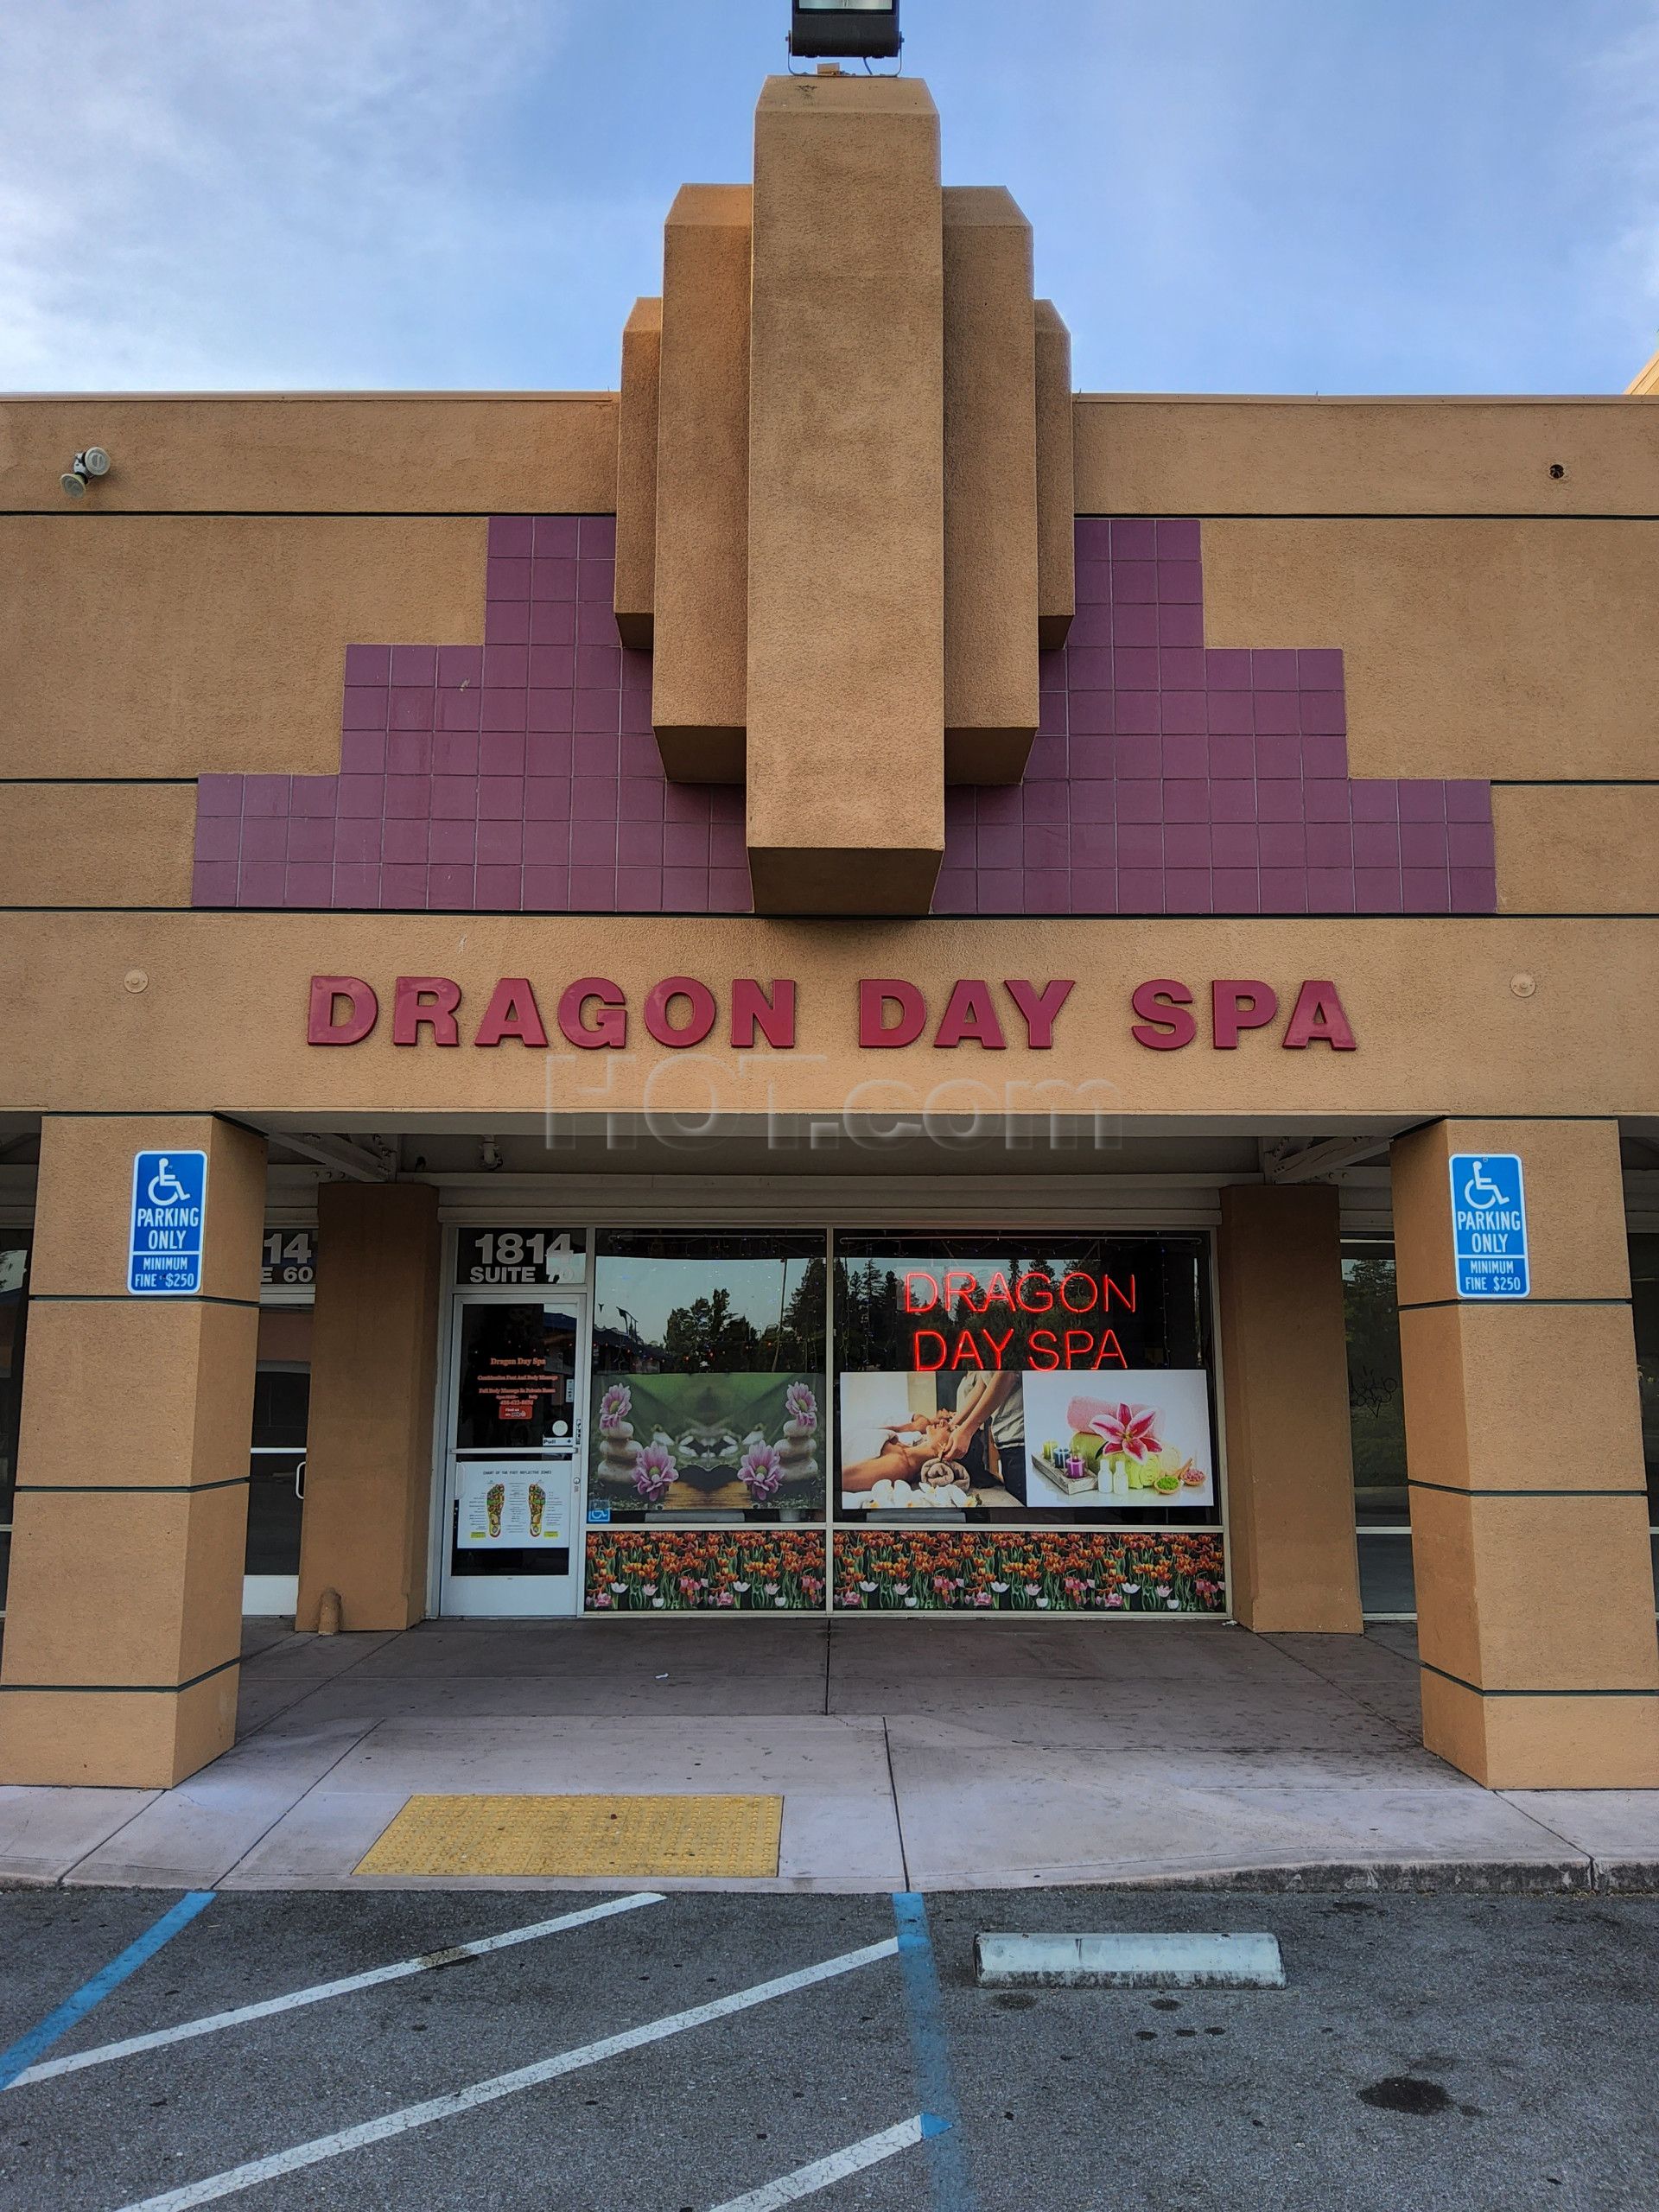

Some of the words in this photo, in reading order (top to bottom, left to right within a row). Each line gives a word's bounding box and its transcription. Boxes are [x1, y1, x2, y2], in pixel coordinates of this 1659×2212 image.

[307, 976, 796, 1049] DRAGON
[858, 978, 1077, 1051] DAY
[1131, 978, 1357, 1052] SPA
[137, 1207, 200, 1227] PARKING
[1457, 1211, 1521, 1231] PARKING
[148, 1230, 187, 1249] ONLY
[475, 1233, 574, 1264] 1814
[1471, 1233, 1509, 1253] ONLY
[143, 1256, 188, 1271] MINIMUM
[1470, 1261, 1514, 1274] MINIMUM
[135, 1273, 157, 1287] FINE
[165, 1272, 194, 1288] $250
[283, 1267, 314, 1283] 60
[470, 1267, 536, 1283] SUITE
[1465, 1276, 1488, 1291] FINE
[1493, 1276, 1521, 1292] $250
[905, 1272, 1136, 1313] DRAGON
[914, 1328, 1014, 1371] DAY
[1028, 1329, 1128, 1371] SPA
[490, 1357, 517, 1366] Dragon
[518, 1357, 532, 1366] Day
[533, 1357, 546, 1366] Spa
